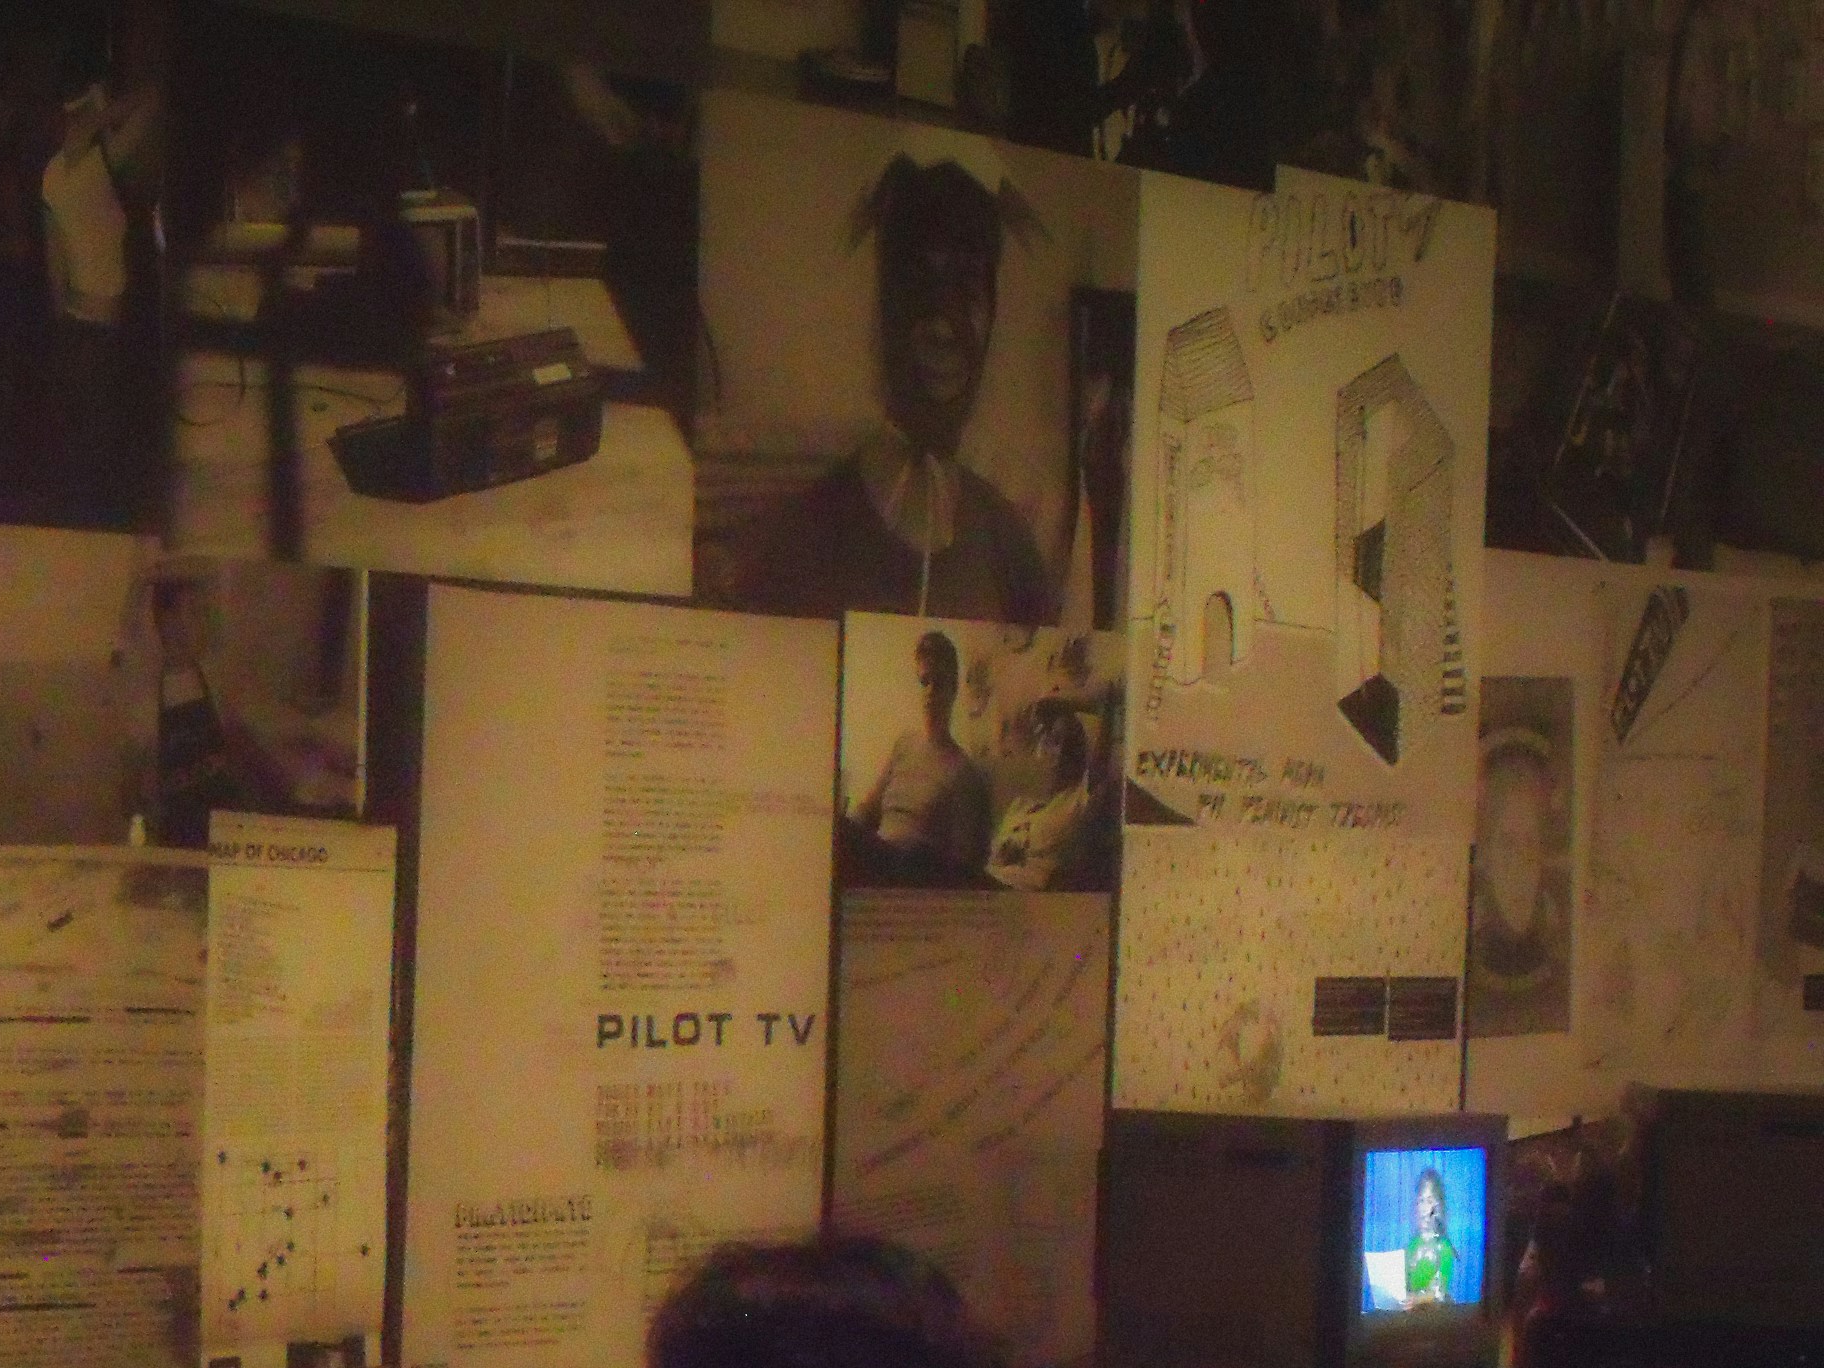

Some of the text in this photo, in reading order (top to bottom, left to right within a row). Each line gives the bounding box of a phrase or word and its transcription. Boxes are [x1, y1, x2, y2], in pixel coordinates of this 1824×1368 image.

[245, 843, 263, 860] OF
[267, 844, 328, 863] CHICAGO
[595, 1012, 817, 1050] PILOT TV
